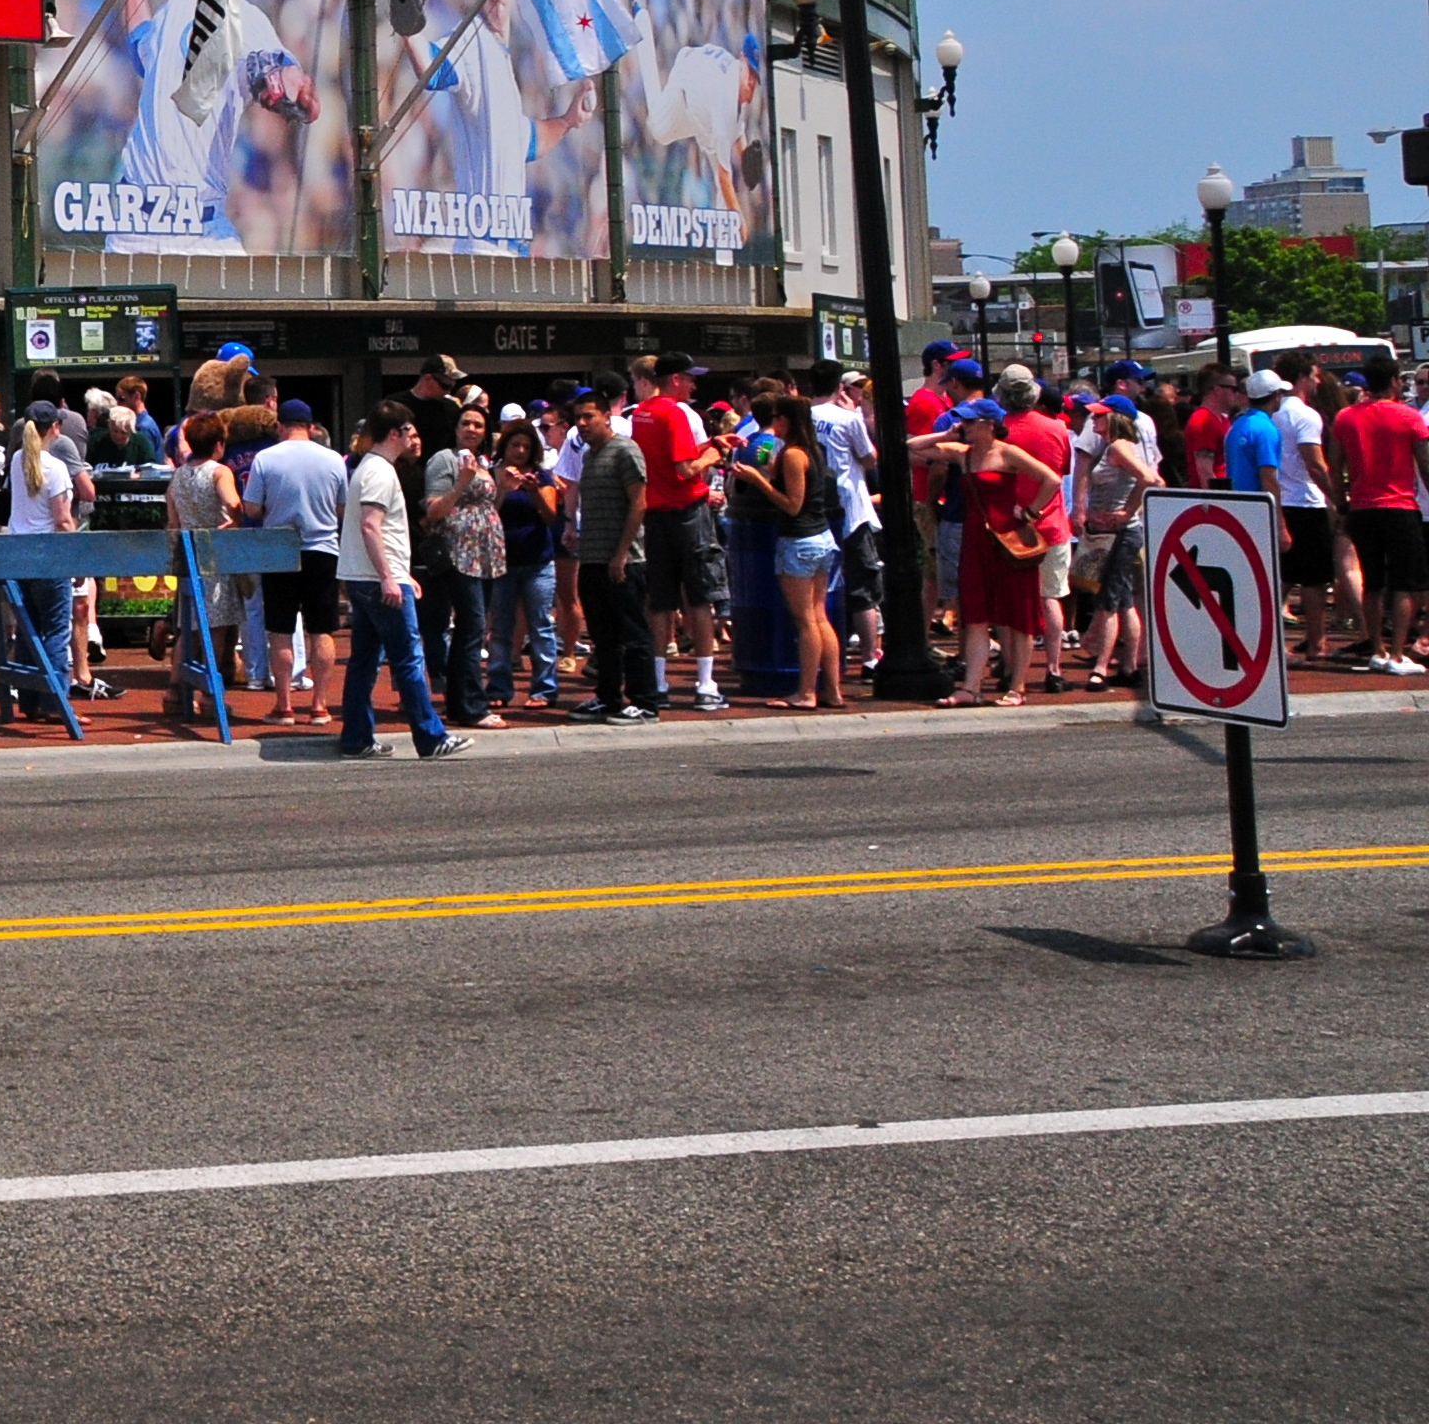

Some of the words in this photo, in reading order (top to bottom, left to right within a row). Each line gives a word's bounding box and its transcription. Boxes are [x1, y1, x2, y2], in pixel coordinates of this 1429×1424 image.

[52, 181, 204, 235] GARZA
[391, 189, 534, 241] MAHOLM
[629, 202, 745, 251] DEMPSTER
[368, 335, 420, 352] INSPECTION
[494, 324, 538, 351] GATE
[545, 325, 556, 350] F
